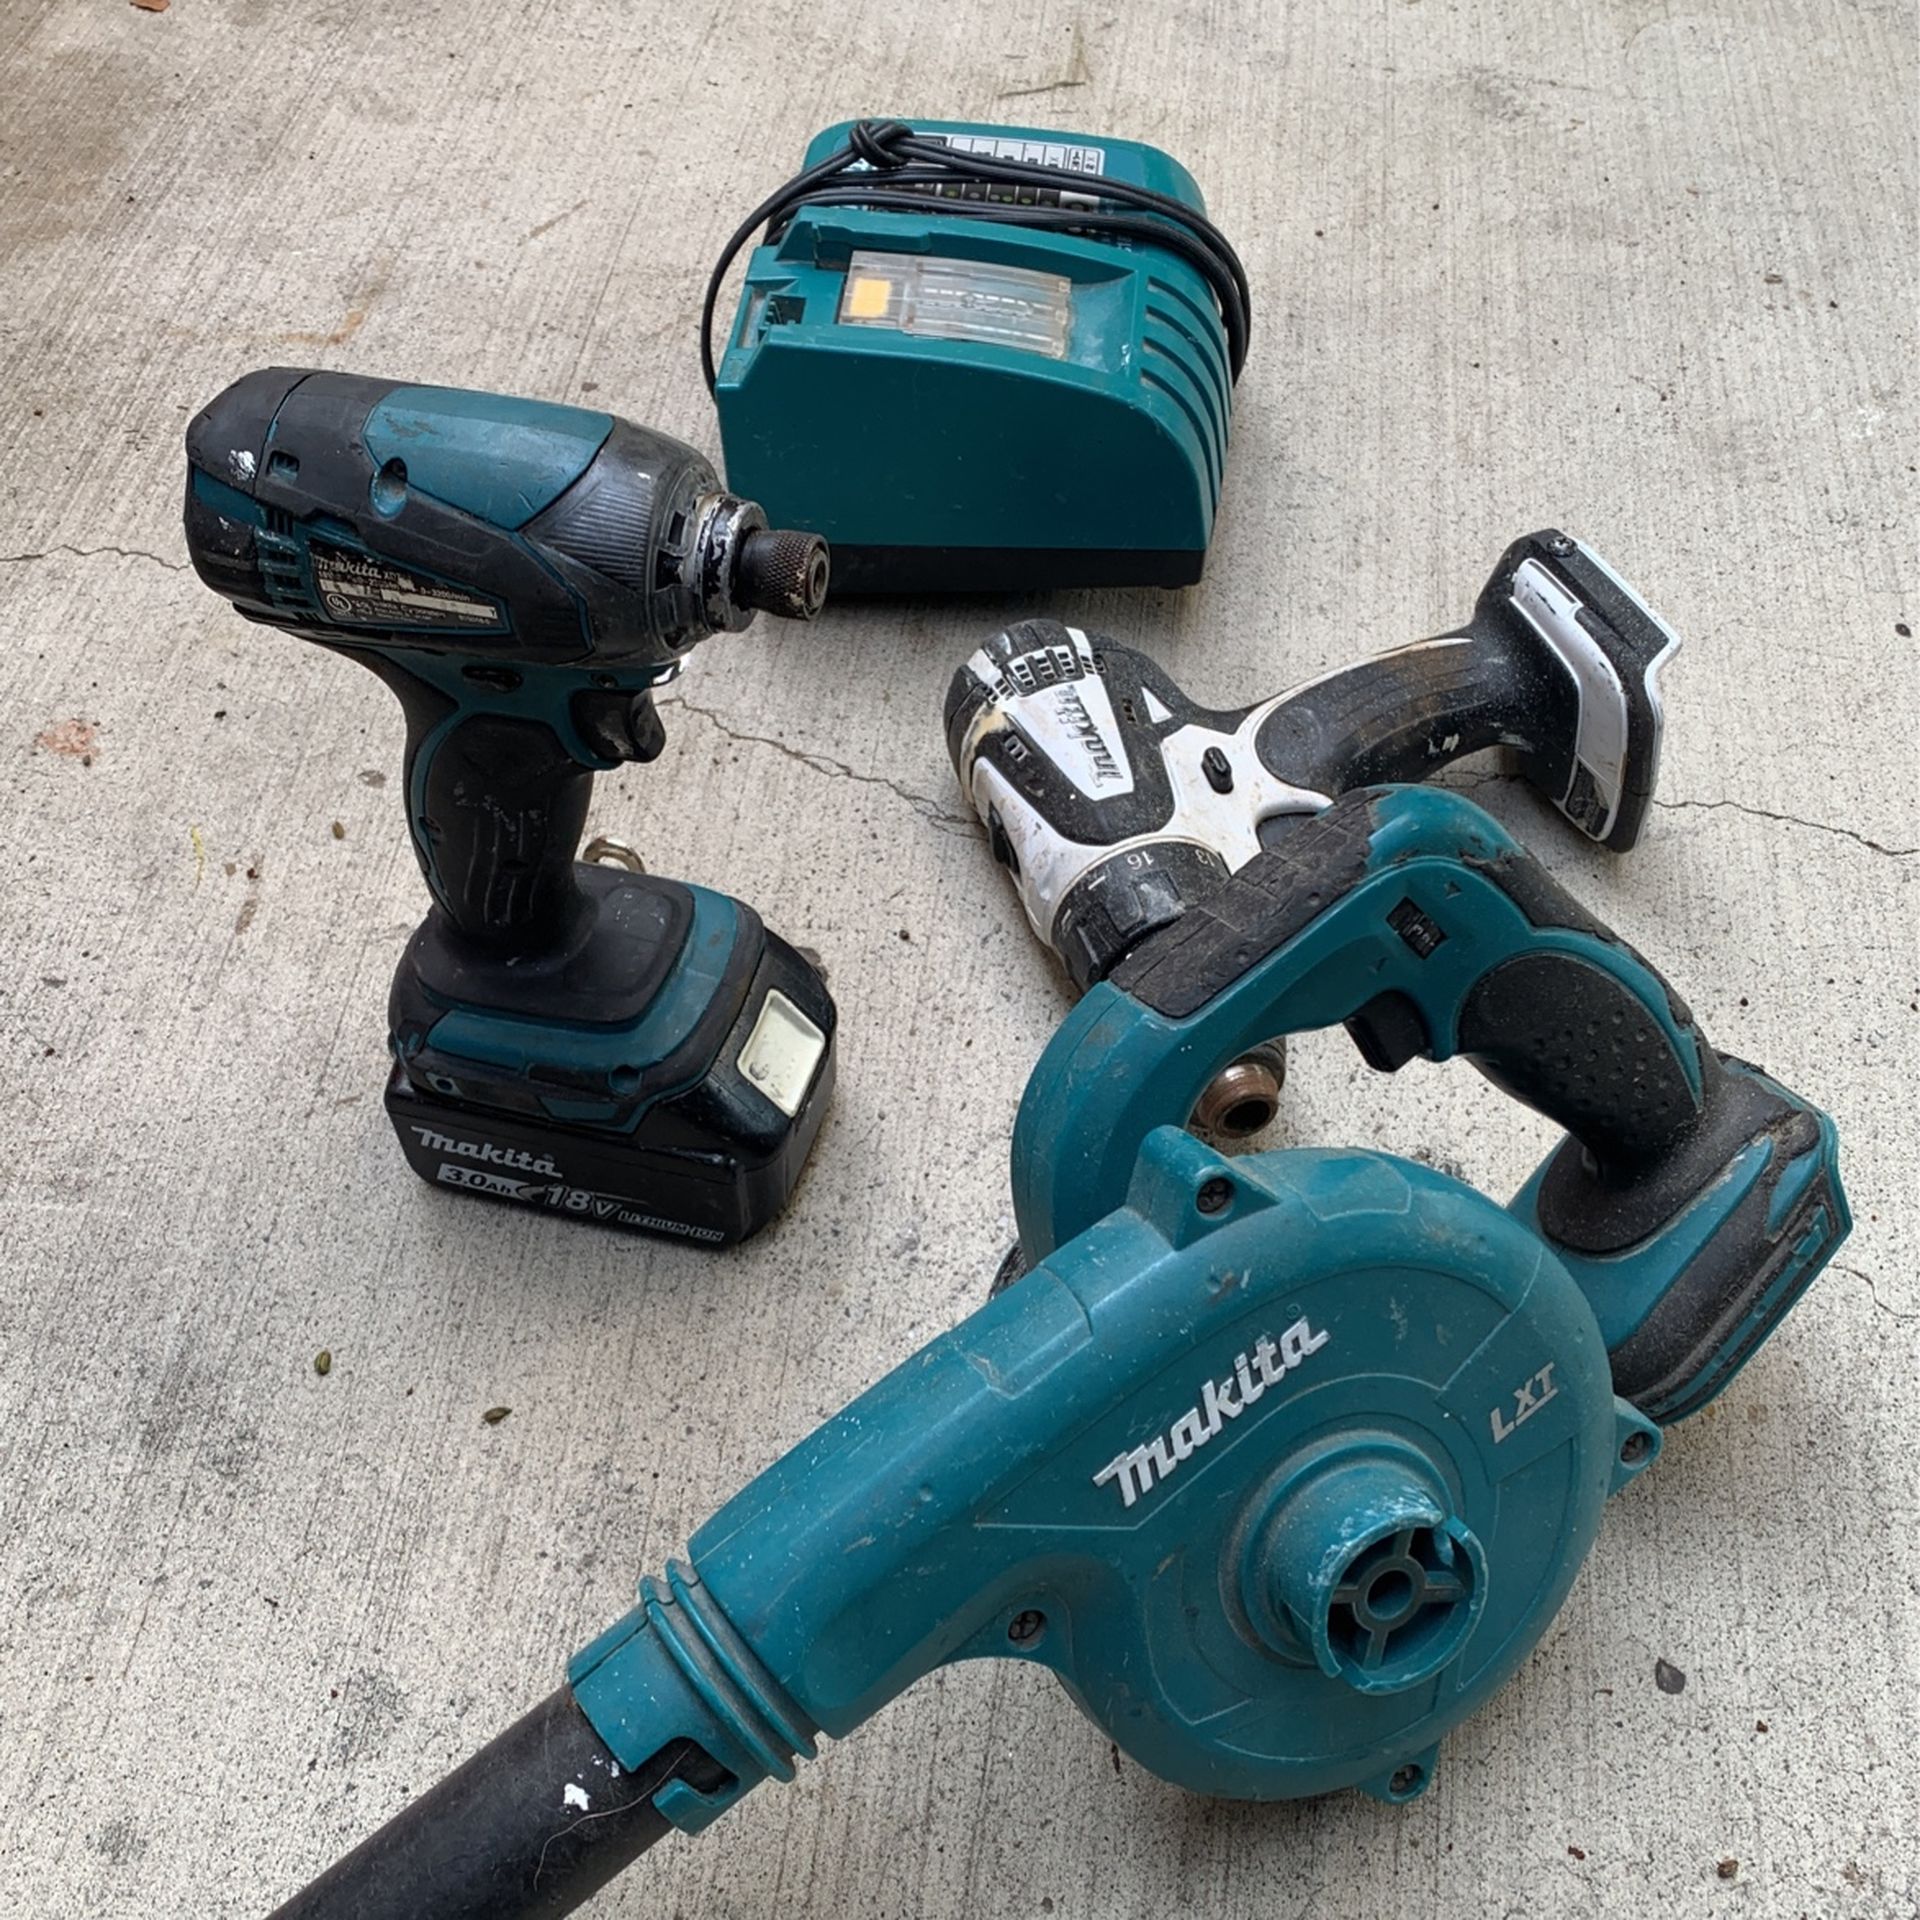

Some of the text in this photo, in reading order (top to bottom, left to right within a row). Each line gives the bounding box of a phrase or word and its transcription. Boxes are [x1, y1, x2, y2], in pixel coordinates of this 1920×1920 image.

[1126, 850, 1154, 871] 16
[411, 1126, 563, 1178] makita
[445, 1168, 512, 1196] 3.0Ah
[1093, 1315, 1332, 1508] makita
[1489, 1361, 1560, 1445] LXT
